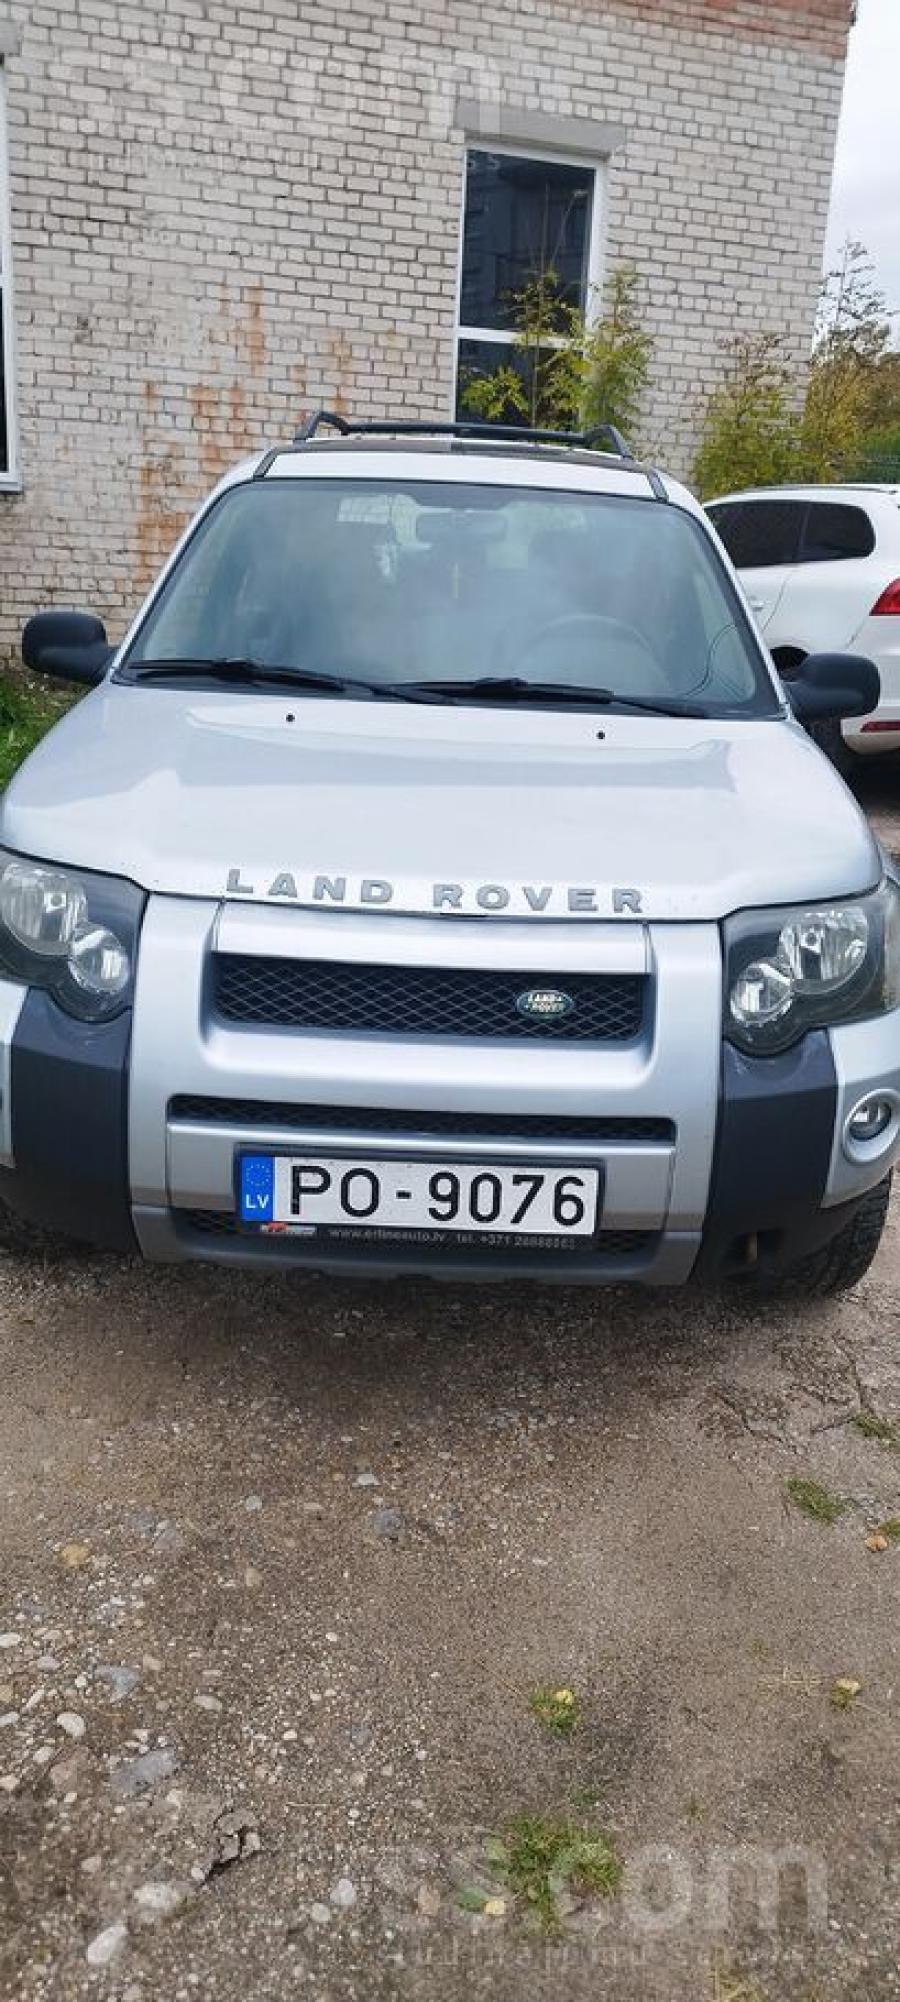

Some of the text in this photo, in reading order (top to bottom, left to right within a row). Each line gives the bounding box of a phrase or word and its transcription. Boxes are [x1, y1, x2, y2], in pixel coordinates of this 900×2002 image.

[226, 869, 643, 914] LAND ROVER
[246, 1193, 270, 1209] LV
